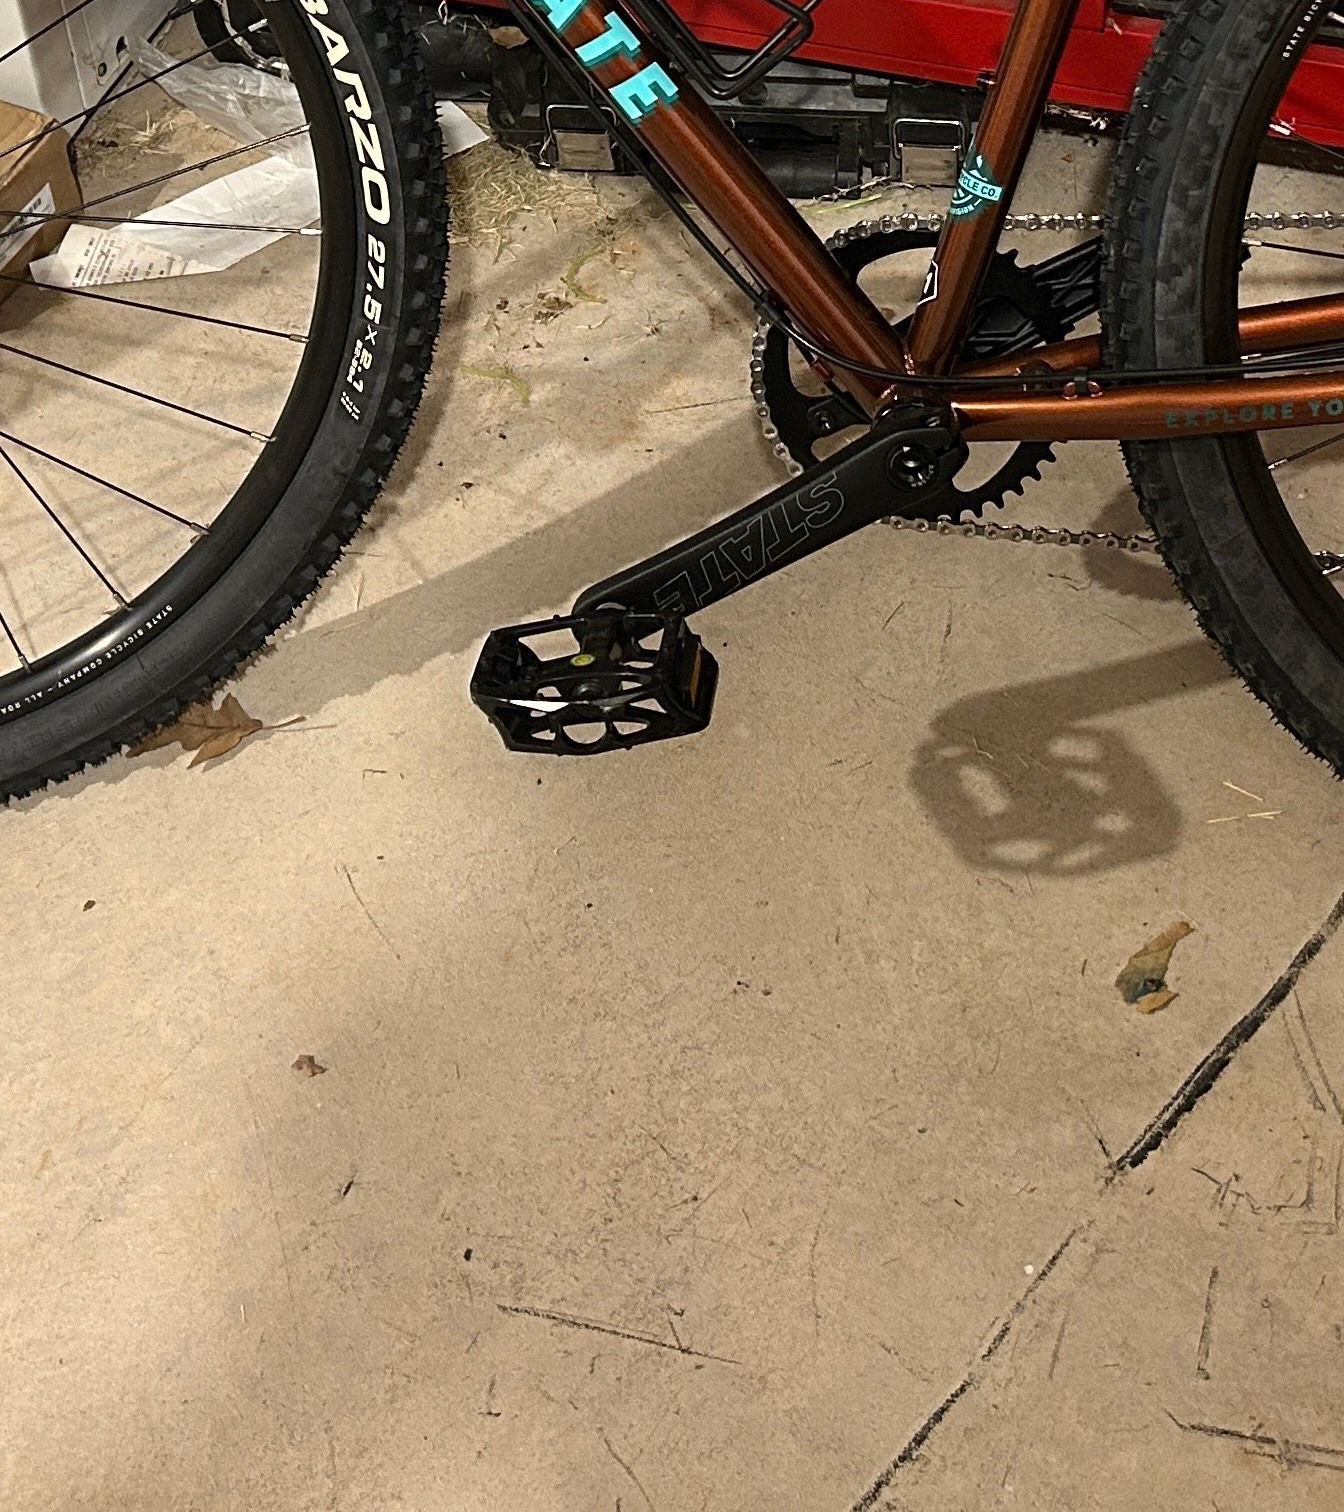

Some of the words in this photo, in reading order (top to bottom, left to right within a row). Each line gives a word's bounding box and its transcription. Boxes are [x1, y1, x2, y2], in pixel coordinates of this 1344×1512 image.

[1282, 25, 1305, 59] STATE
[1166, 401, 1296, 430] EXPLORE
[653, 471, 845, 611] STATE
[145, 604, 173, 630] STATE
[105, 628, 144, 660] BICYCLE
[57, 658, 103, 689] COMPANY
[25, 690, 43, 704] ALL
